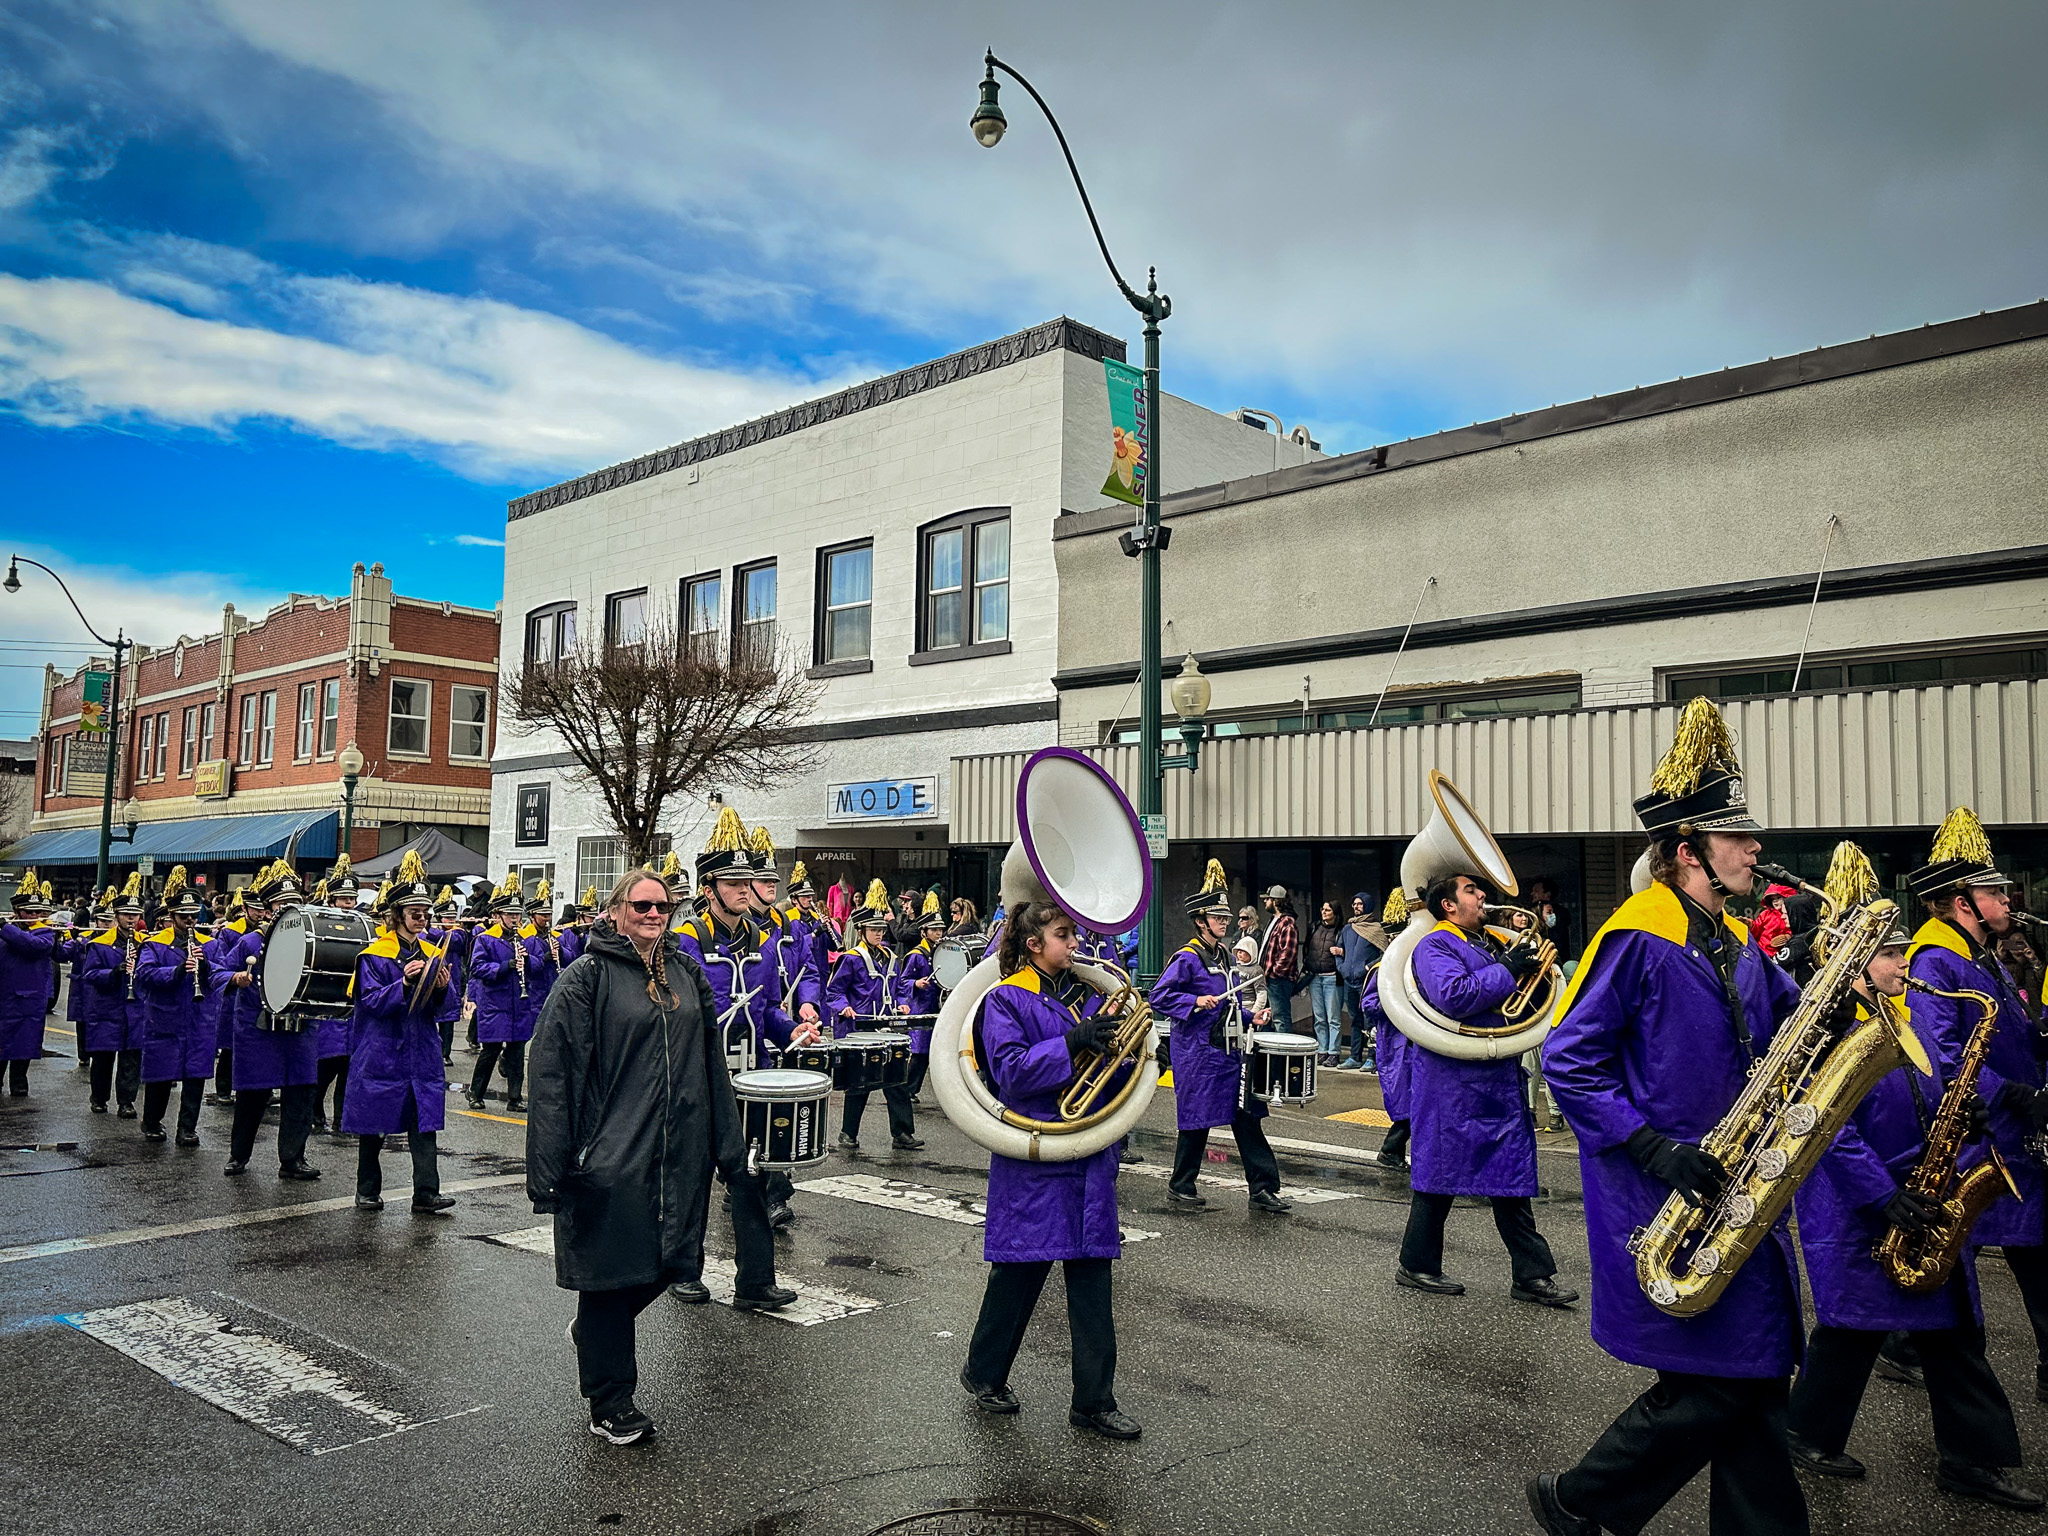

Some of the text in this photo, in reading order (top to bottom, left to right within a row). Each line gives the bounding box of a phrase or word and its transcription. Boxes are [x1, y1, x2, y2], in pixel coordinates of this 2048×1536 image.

[1133, 388, 1148, 499] SUMNER
[99, 681, 111, 729] SUMNER
[836, 785, 925, 813] MODE
[1140, 818, 1146, 829] 3
[815, 852, 857, 861] APPAREL
[901, 852, 924, 861] GIFT
[284, 917, 302, 931] YAMAHA
[798, 1117, 811, 1157] YAMAHA
